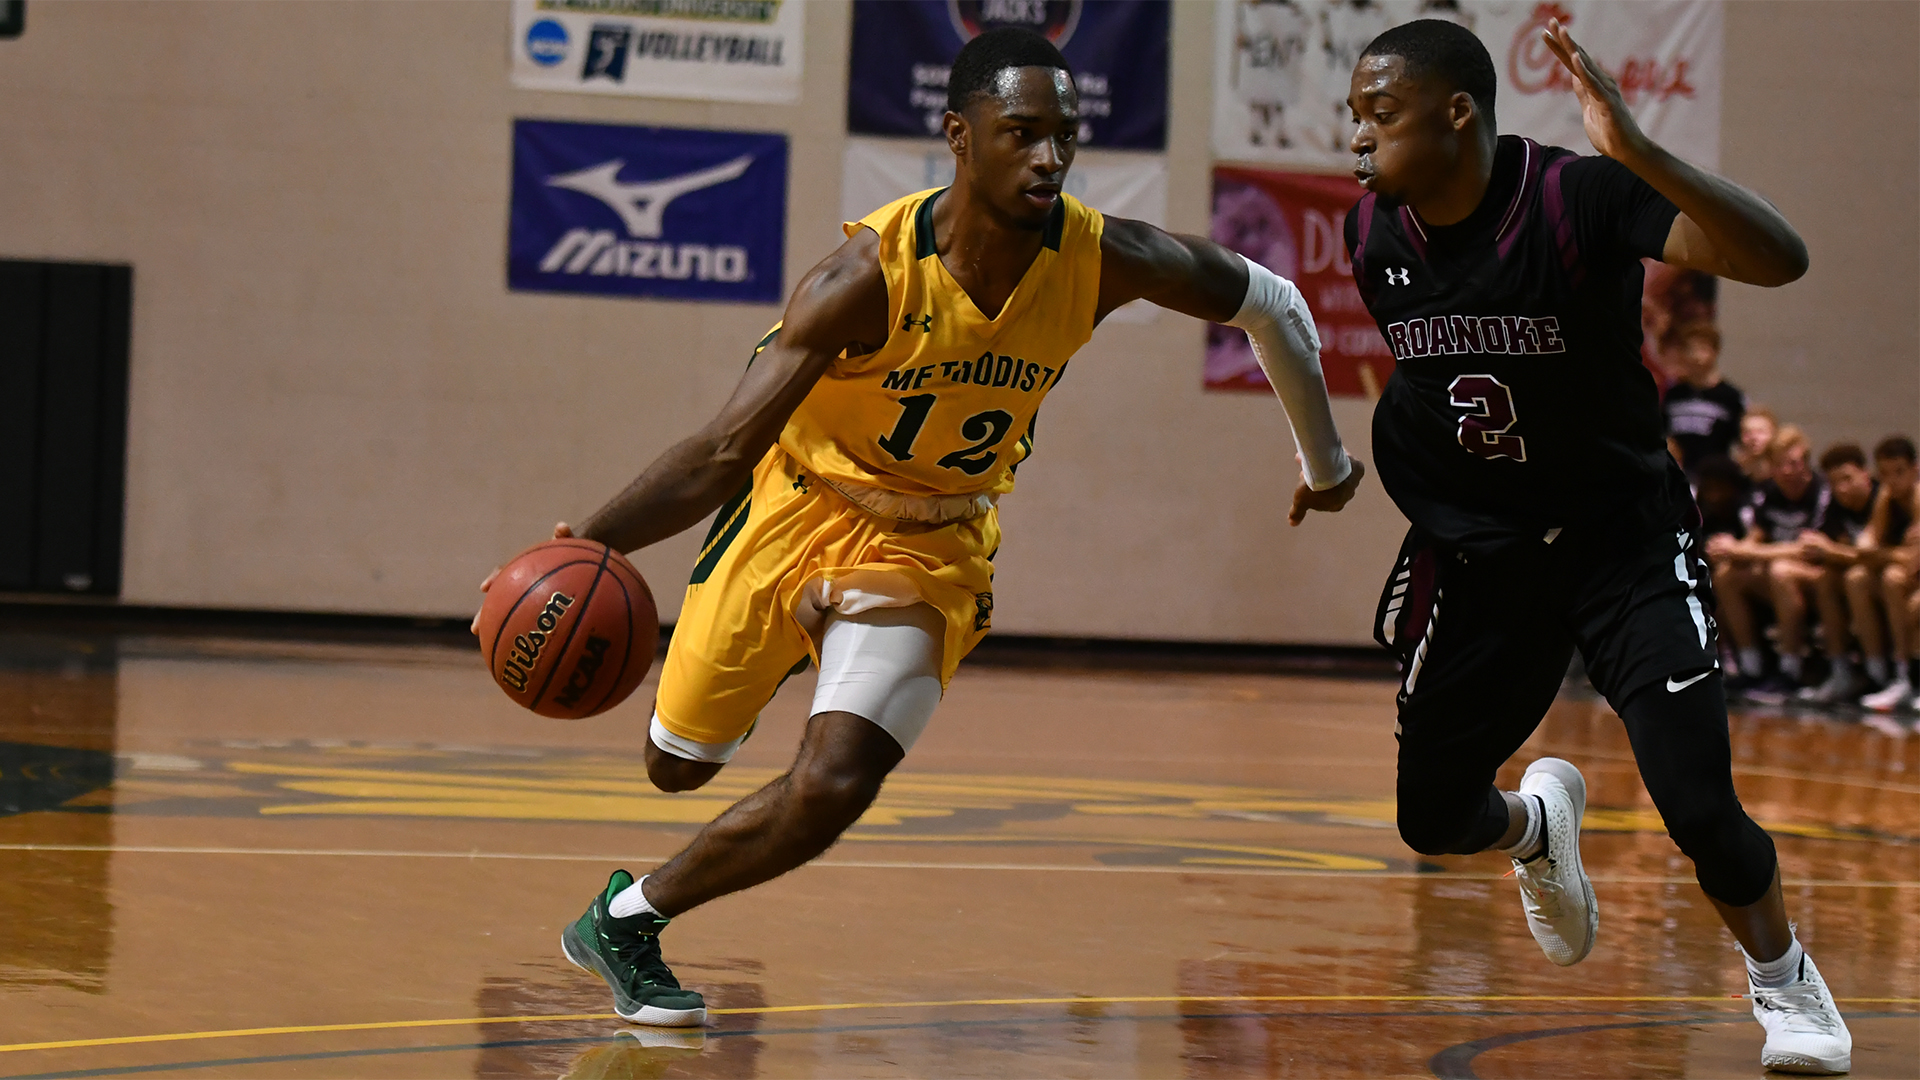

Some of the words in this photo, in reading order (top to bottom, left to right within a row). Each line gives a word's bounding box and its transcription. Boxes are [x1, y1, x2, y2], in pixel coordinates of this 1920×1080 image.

[637, 31, 785, 67] VOLLEYBALL
[539, 229, 748, 283] MIZUNO
[1388, 315, 1566, 360] ROANOKE
[881, 350, 1055, 392] METHODIST
[877, 393, 1014, 477] 12
[1447, 374, 1527, 462] 2
[502, 591, 576, 693] Wilson
[553, 635, 612, 710] NCAA
